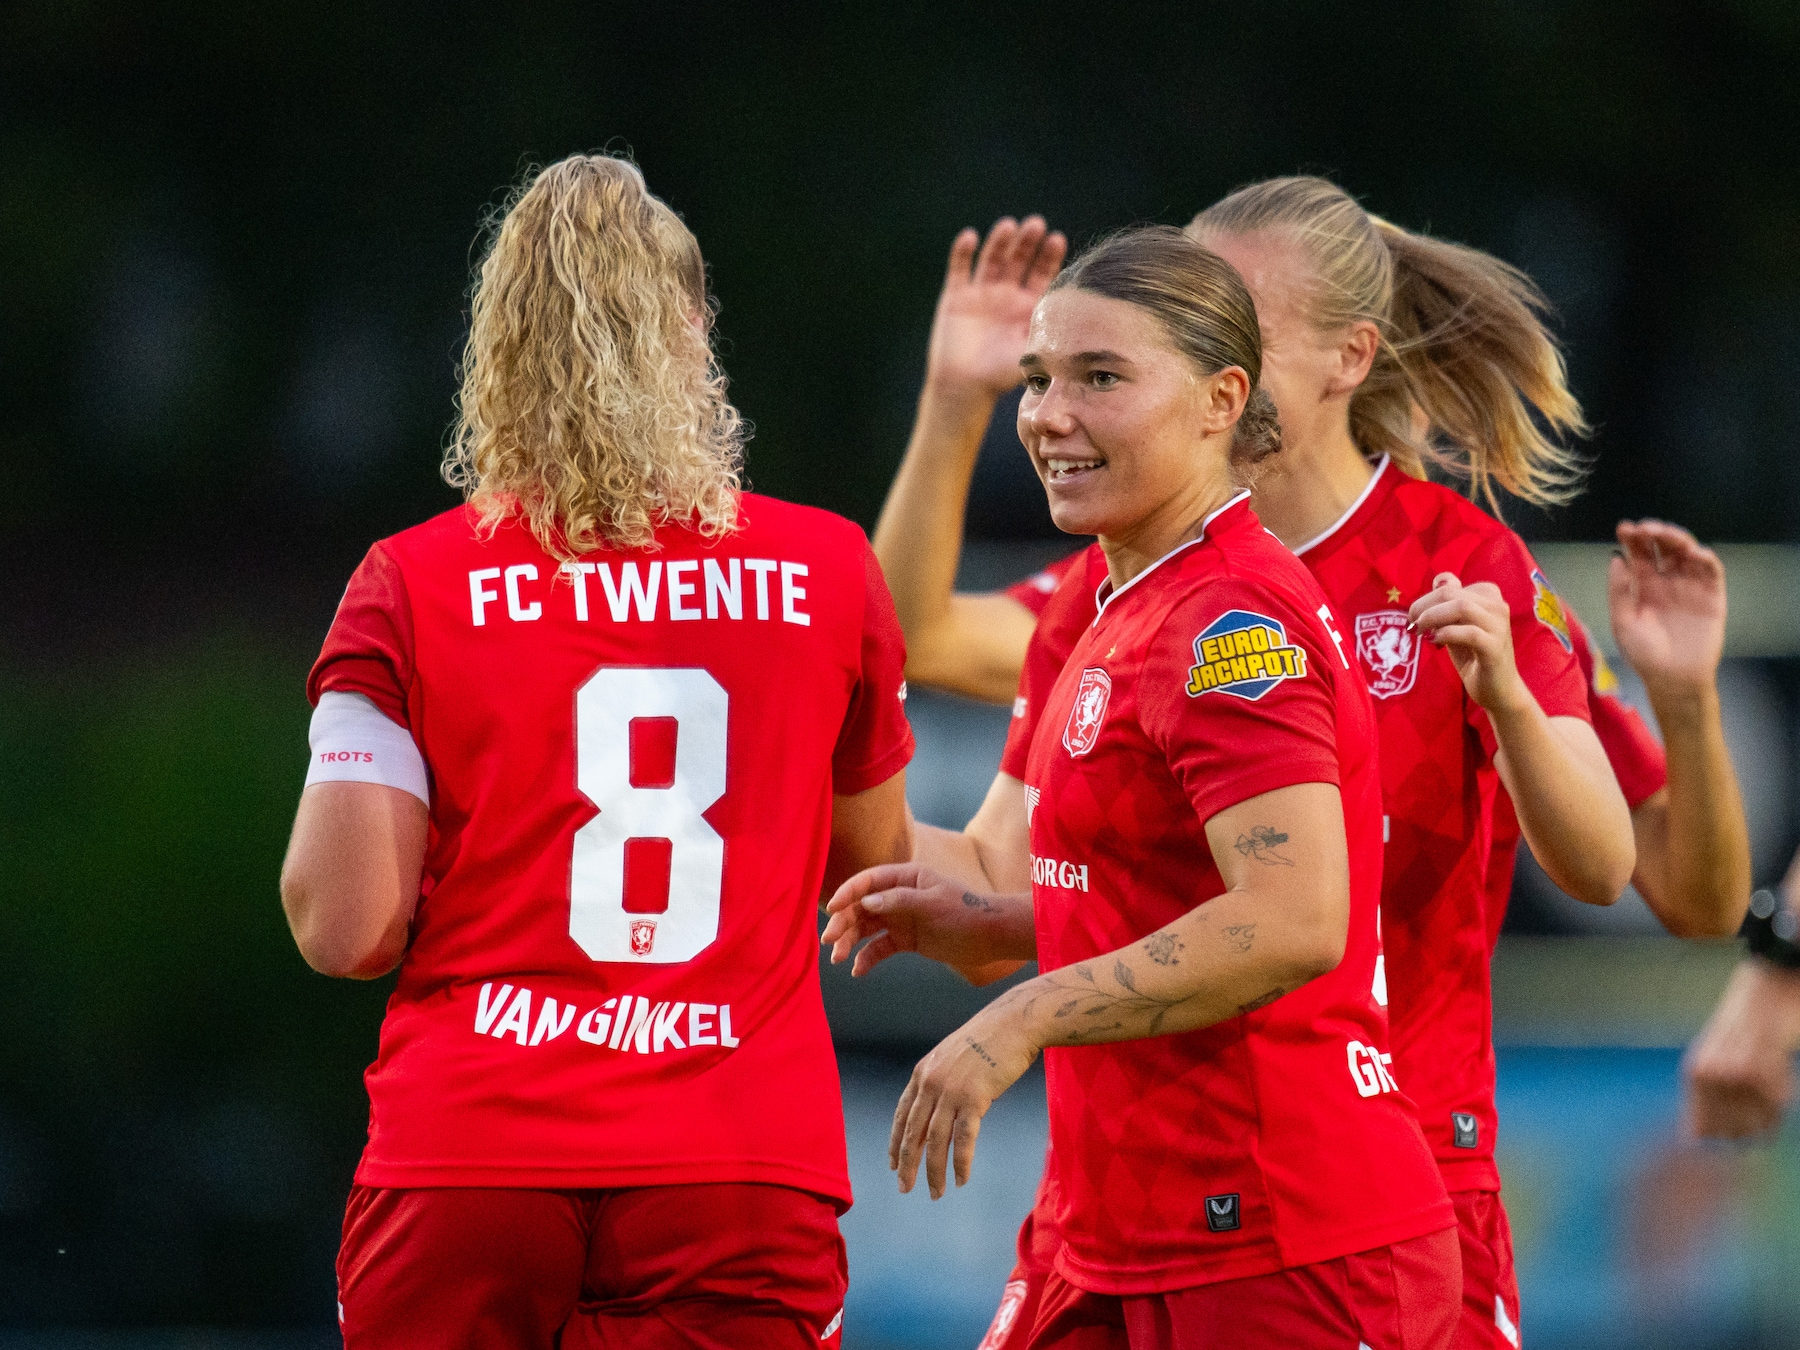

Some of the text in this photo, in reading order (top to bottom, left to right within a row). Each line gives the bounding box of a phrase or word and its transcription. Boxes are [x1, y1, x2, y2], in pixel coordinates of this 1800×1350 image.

[469, 558, 811, 627] FC TWENTE
[1188, 650, 1296, 694] JACKPOT
[1201, 627, 1269, 664] EURO
[320, 751, 374, 764] TROTS
[569, 668, 730, 963] 8
[474, 983, 740, 1054] VAN GINKEL
